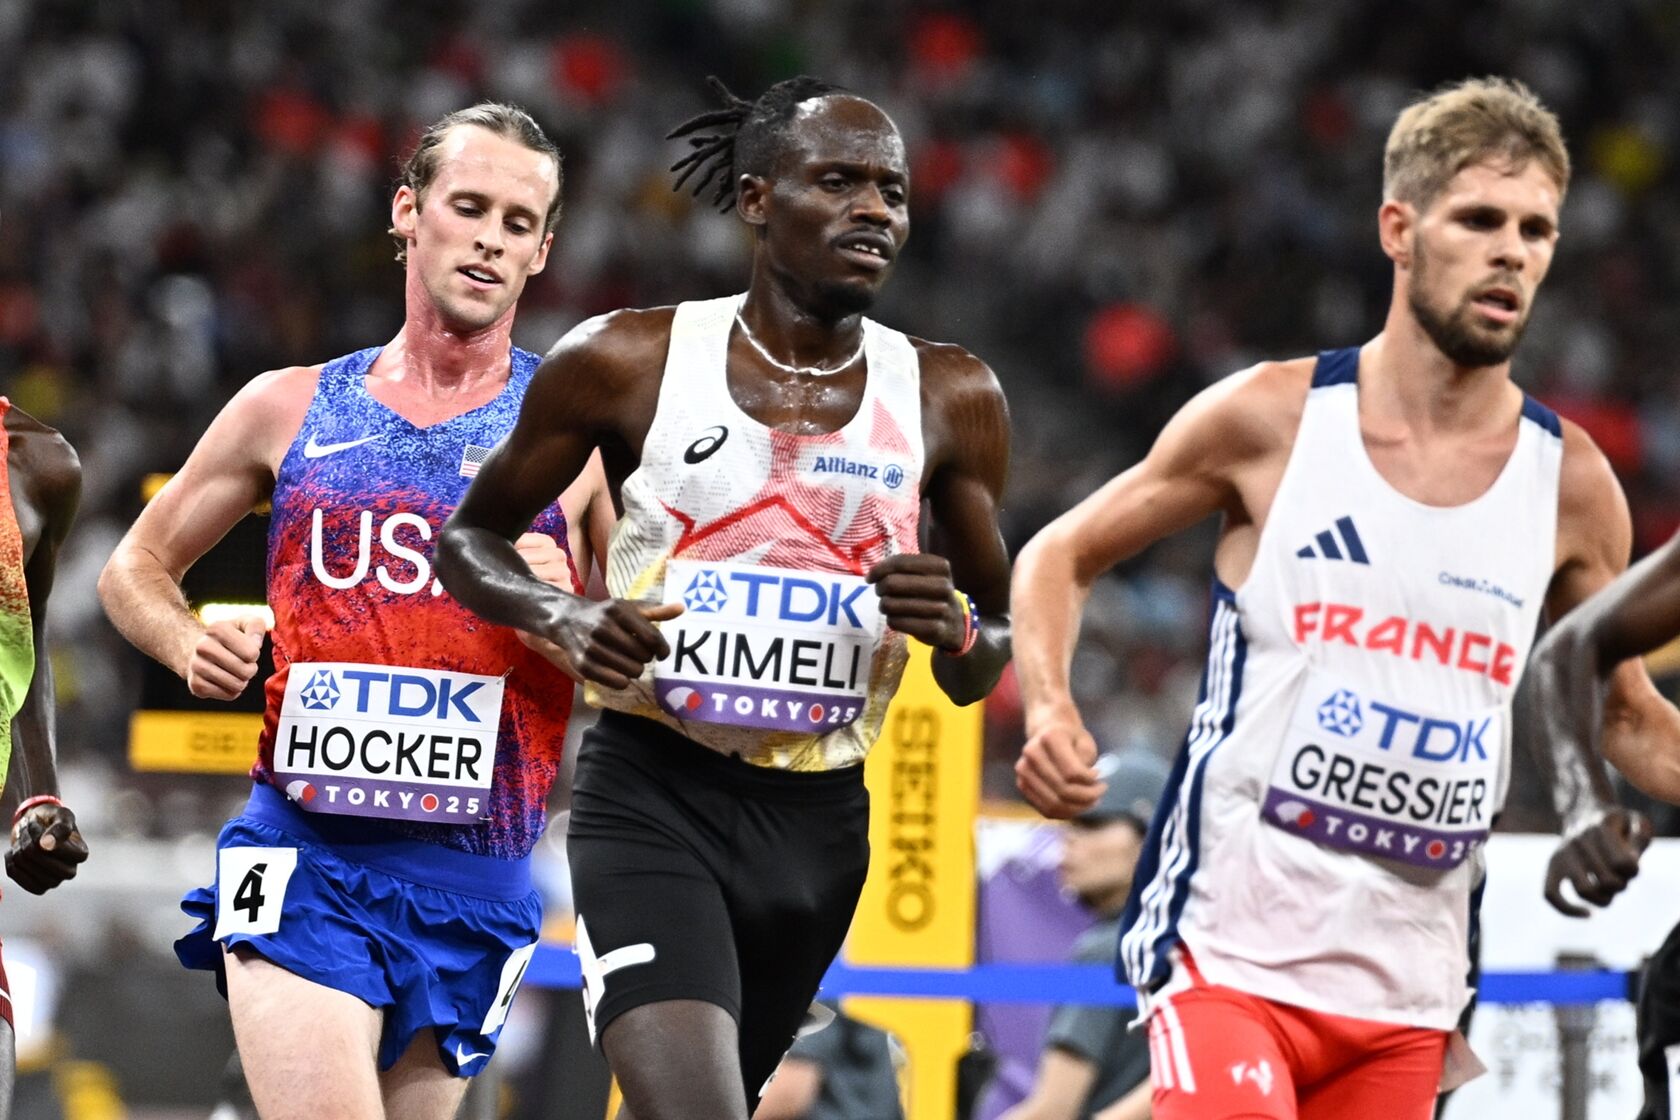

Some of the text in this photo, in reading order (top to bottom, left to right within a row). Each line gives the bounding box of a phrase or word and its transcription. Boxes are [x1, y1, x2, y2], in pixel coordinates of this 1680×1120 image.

[813, 456, 878, 479] Allianz
[310, 508, 444, 596] US
[730, 571, 869, 629] TDK
[673, 629, 861, 690] KIMELI
[1293, 602, 1516, 687] FRANCE
[342, 670, 486, 723] TDK
[287, 725, 482, 781] HOCKER
[1369, 701, 1492, 763] TDK
[1291, 744, 1486, 826] GRESSIER
[886, 707, 942, 933] SEIKO
[233, 862, 268, 923] 4
